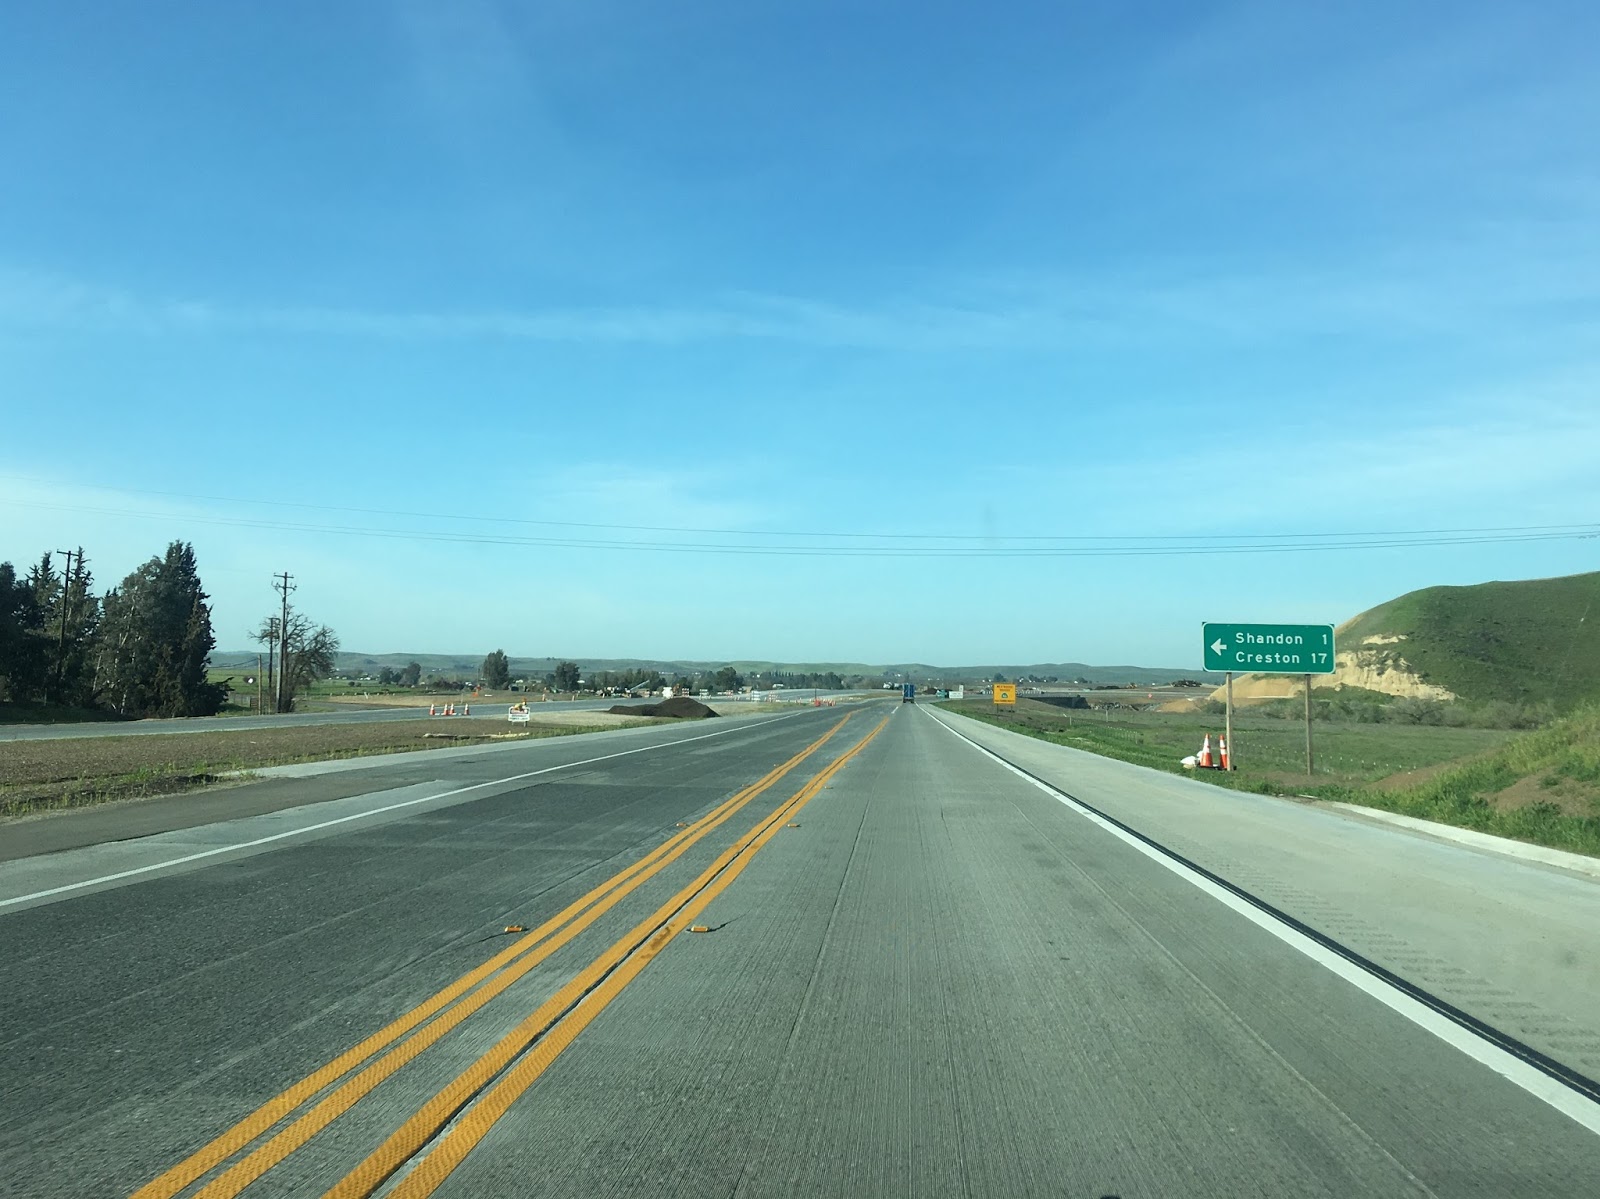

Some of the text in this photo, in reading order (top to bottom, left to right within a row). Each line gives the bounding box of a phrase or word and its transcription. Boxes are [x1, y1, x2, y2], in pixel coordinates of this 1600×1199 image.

[1235, 632, 1328, 645] Shandon 1
[1235, 651, 1328, 664] Creston 17
